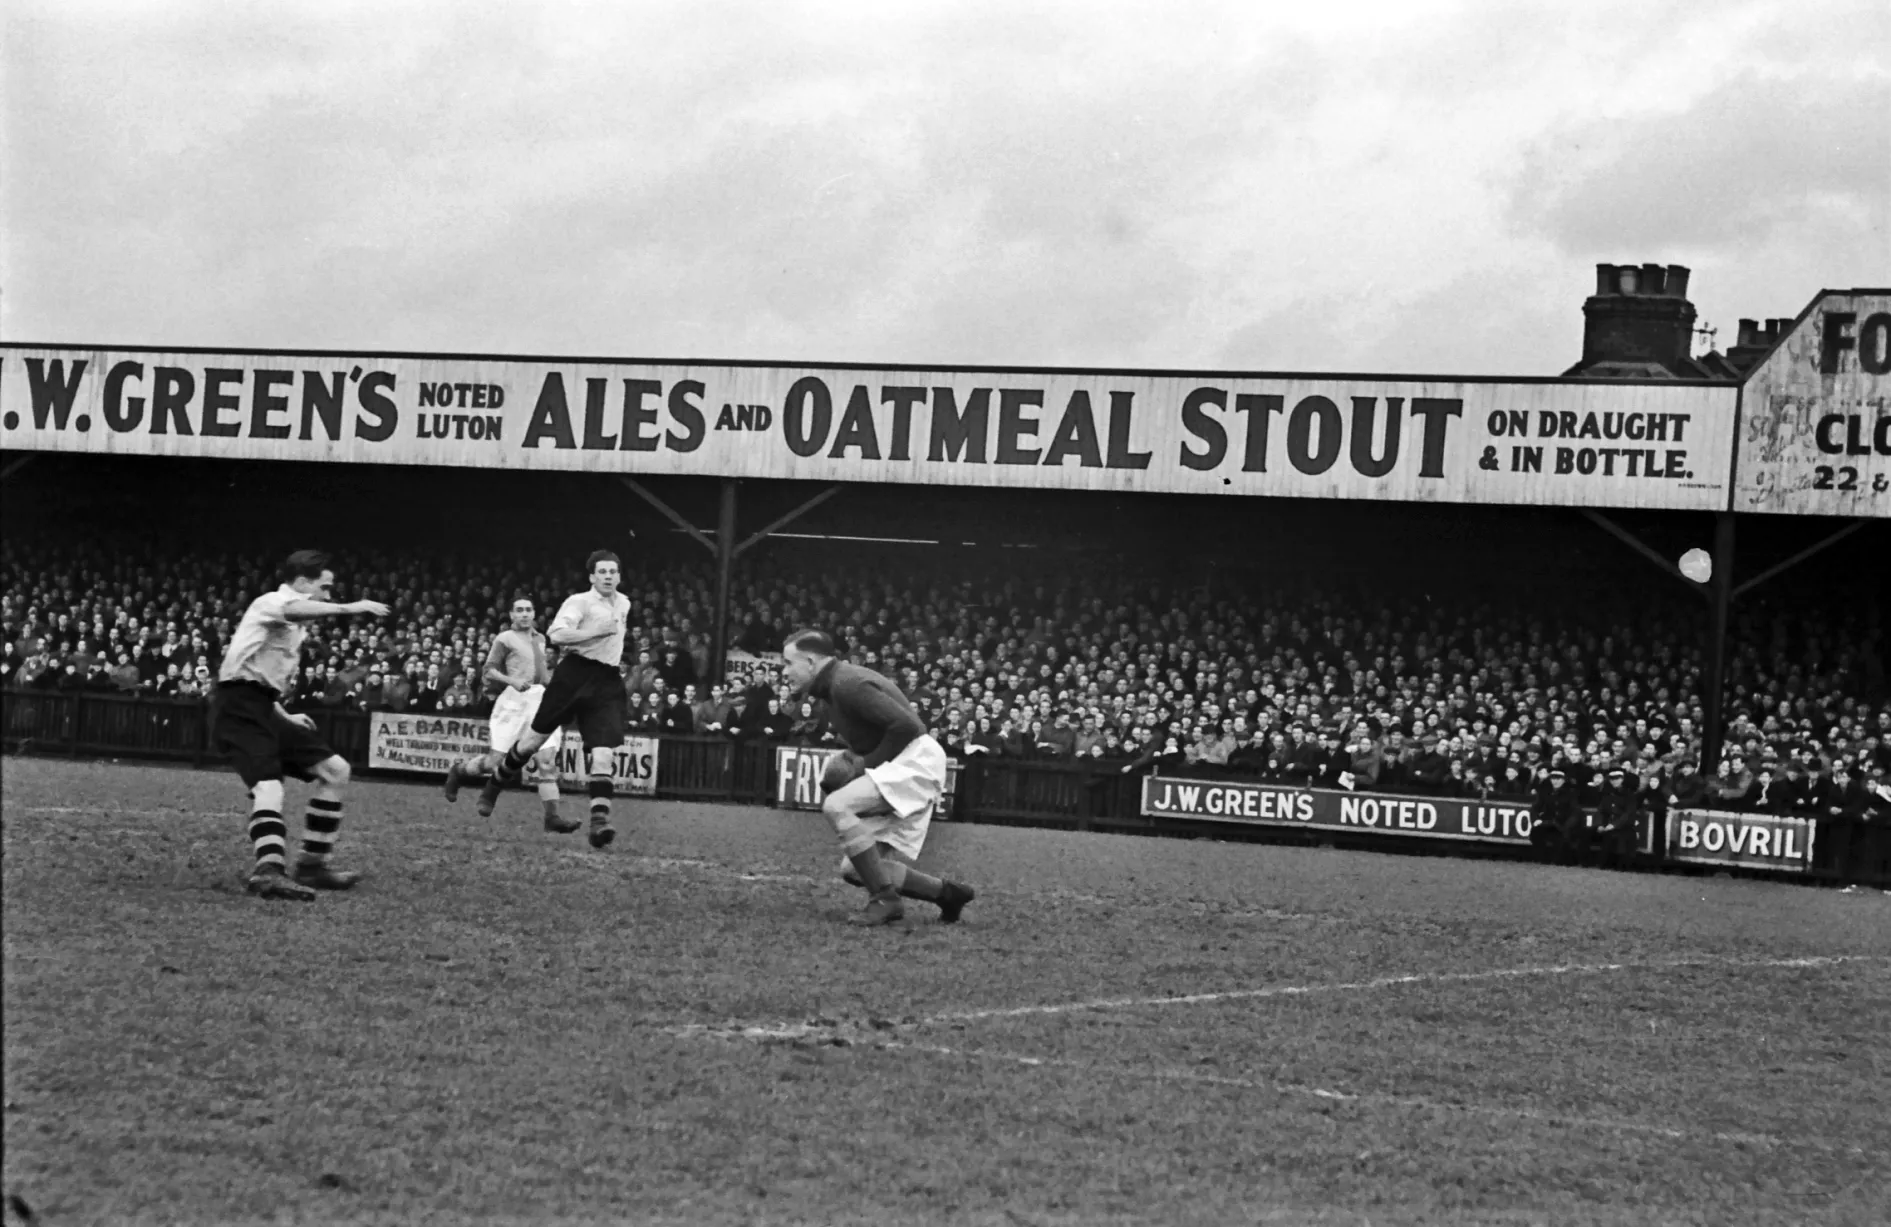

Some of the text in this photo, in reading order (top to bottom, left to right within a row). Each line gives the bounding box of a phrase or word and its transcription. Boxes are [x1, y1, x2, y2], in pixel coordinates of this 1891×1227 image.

[418, 382, 506, 409] NOTED
[416, 413, 503, 441] LUTON
[521, 371, 1463, 478] ALES AND OATMEAL STOUT
[1487, 410, 1691, 441] ON DRAUGHT
[1479, 445, 1694, 479] & IN BOTTLE.
[1812, 465, 1858, 491] 22
[778, 750, 832, 804] FRY
[1340, 797, 1438, 830] NOTED
[1462, 806, 1532, 837] LUTO
[1679, 820, 1803, 858] BOVRIL
